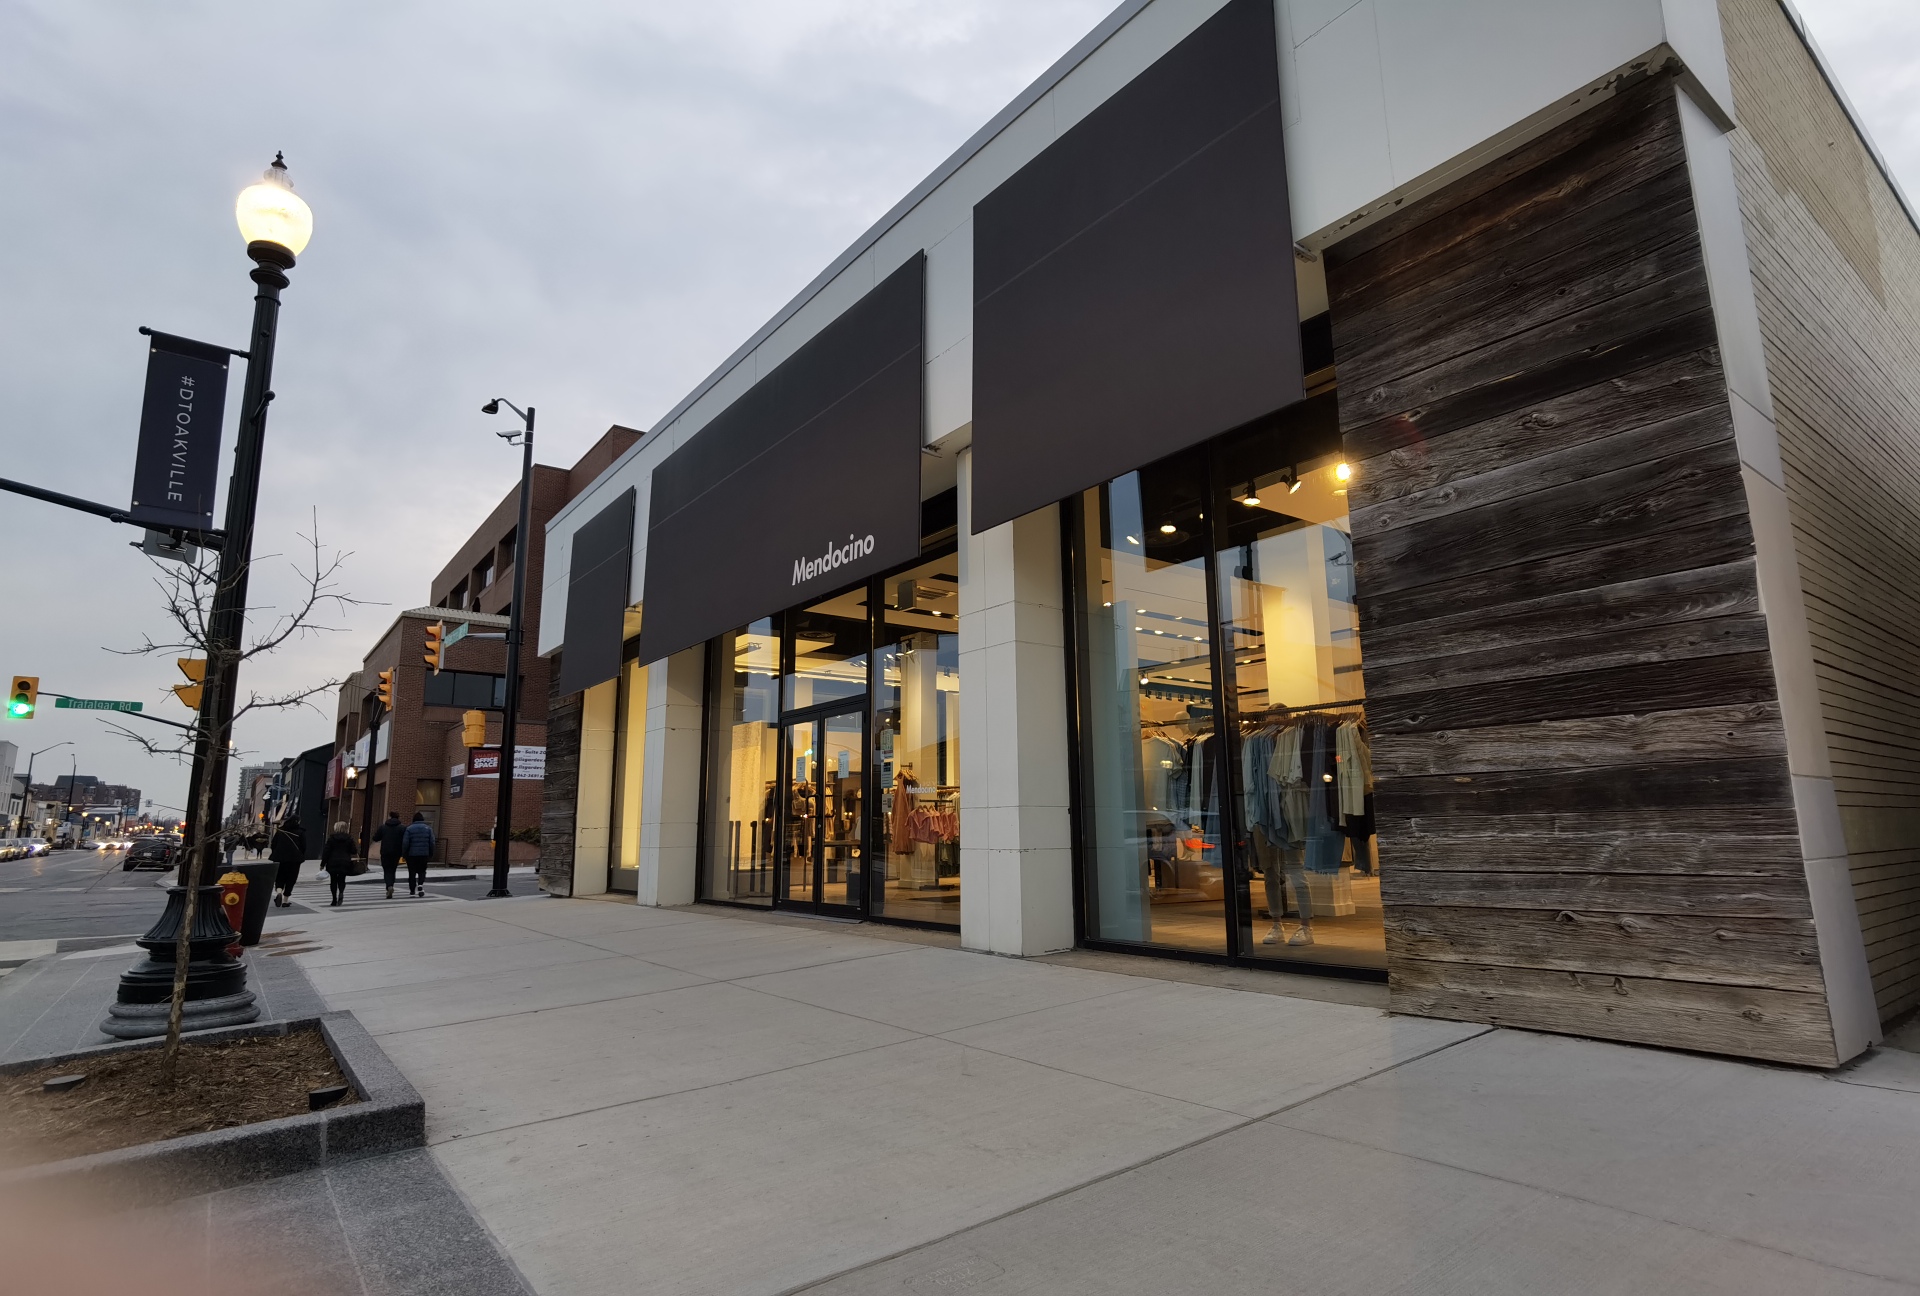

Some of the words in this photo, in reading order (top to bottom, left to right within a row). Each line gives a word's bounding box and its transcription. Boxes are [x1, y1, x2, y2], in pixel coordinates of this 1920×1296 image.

[167, 375, 196, 502] #DTOAKVILLE
[791, 533, 875, 586] Mendocino
[68, 699, 115, 710] Trafalgar
[118, 701, 132, 711] Rd
[906, 783, 937, 794] Mendocino
